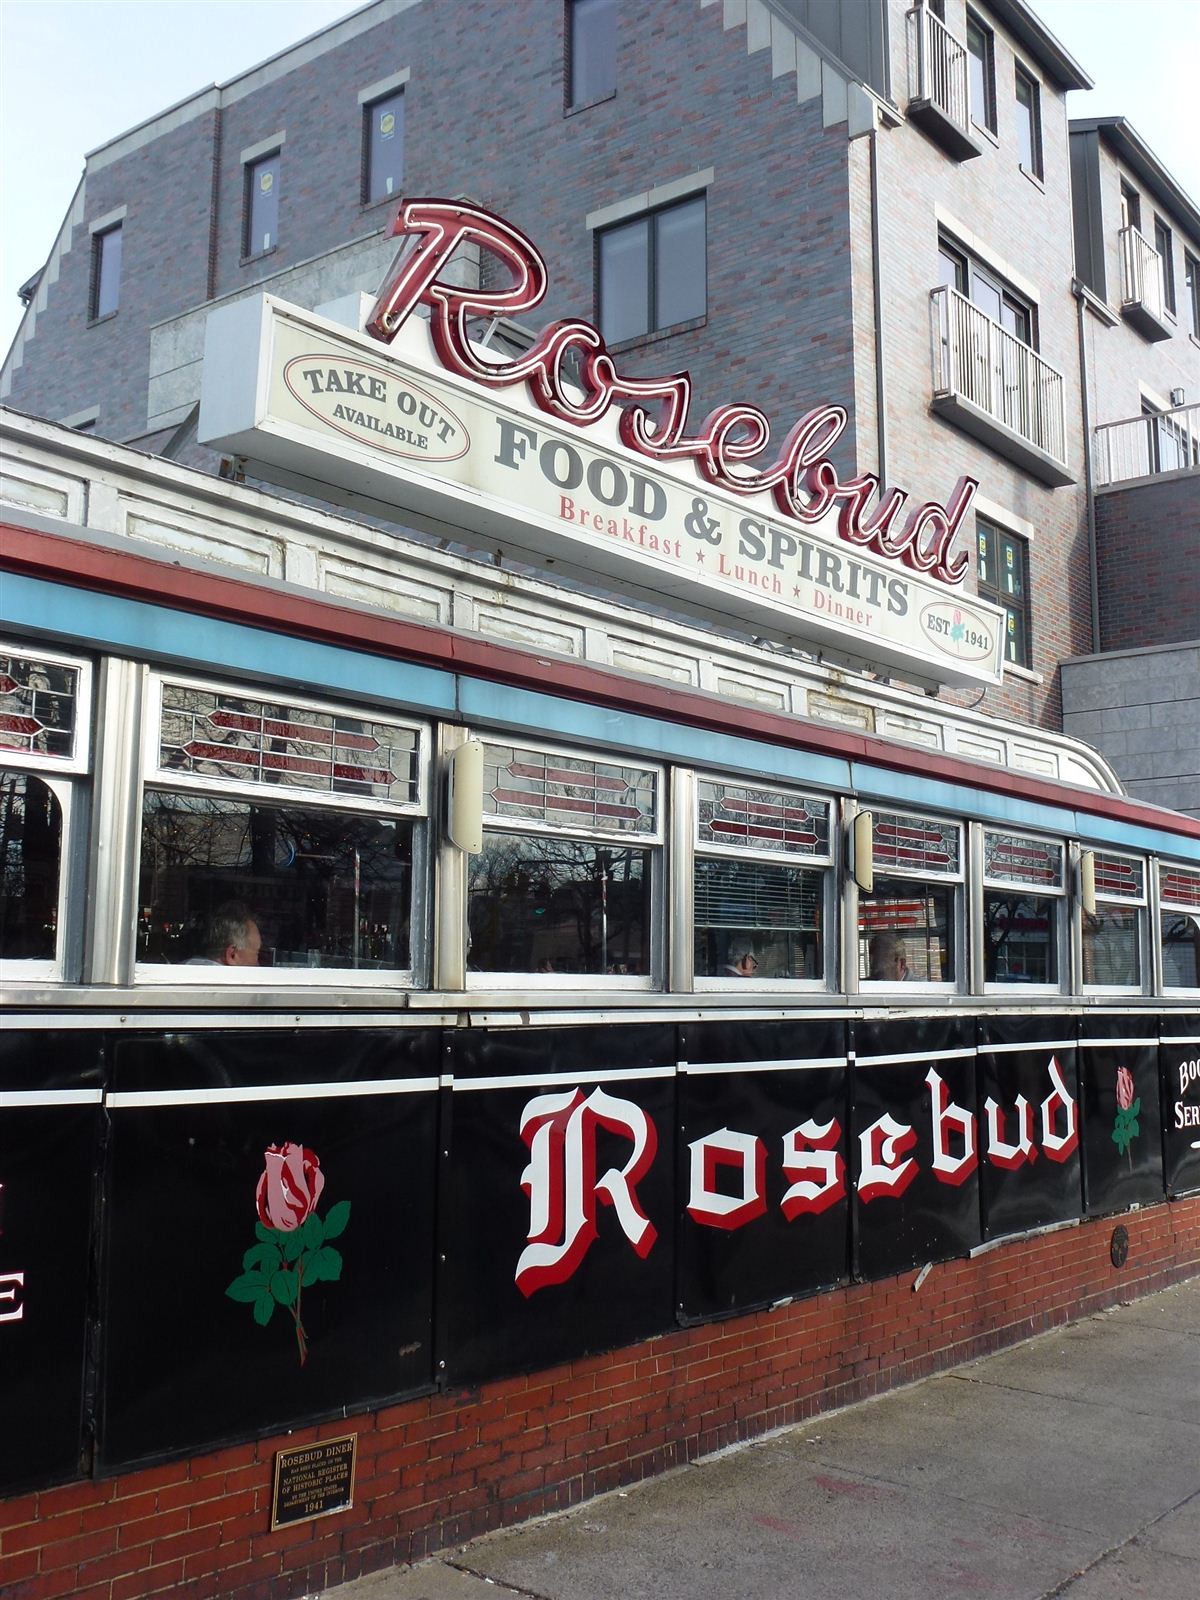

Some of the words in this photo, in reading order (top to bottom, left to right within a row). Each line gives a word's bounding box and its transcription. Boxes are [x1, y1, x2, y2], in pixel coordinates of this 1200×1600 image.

[303, 368, 387, 403] TAKE
[397, 391, 456, 444] OUT
[366, 197, 977, 585] Rosebud
[332, 403, 429, 450] AVAILABLE
[494, 416, 668, 522] FOOD
[684, 497, 722, 546] &
[738, 517, 908, 617] SPIRITS
[559, 494, 682, 559] Breakfast
[718, 553, 782, 595] Lunch
[813, 588, 873, 627] Dinner
[927, 613, 951, 635] EST
[964, 629, 989, 650] 1941
[1174, 1100, 1200, 1130] SER
[514, 1054, 1079, 1298] Rosebud
[280, 1449, 323, 1469] ROSEBUD
[326, 1442, 353, 1457] DINER
[304, 1500, 323, 1513] 1941
